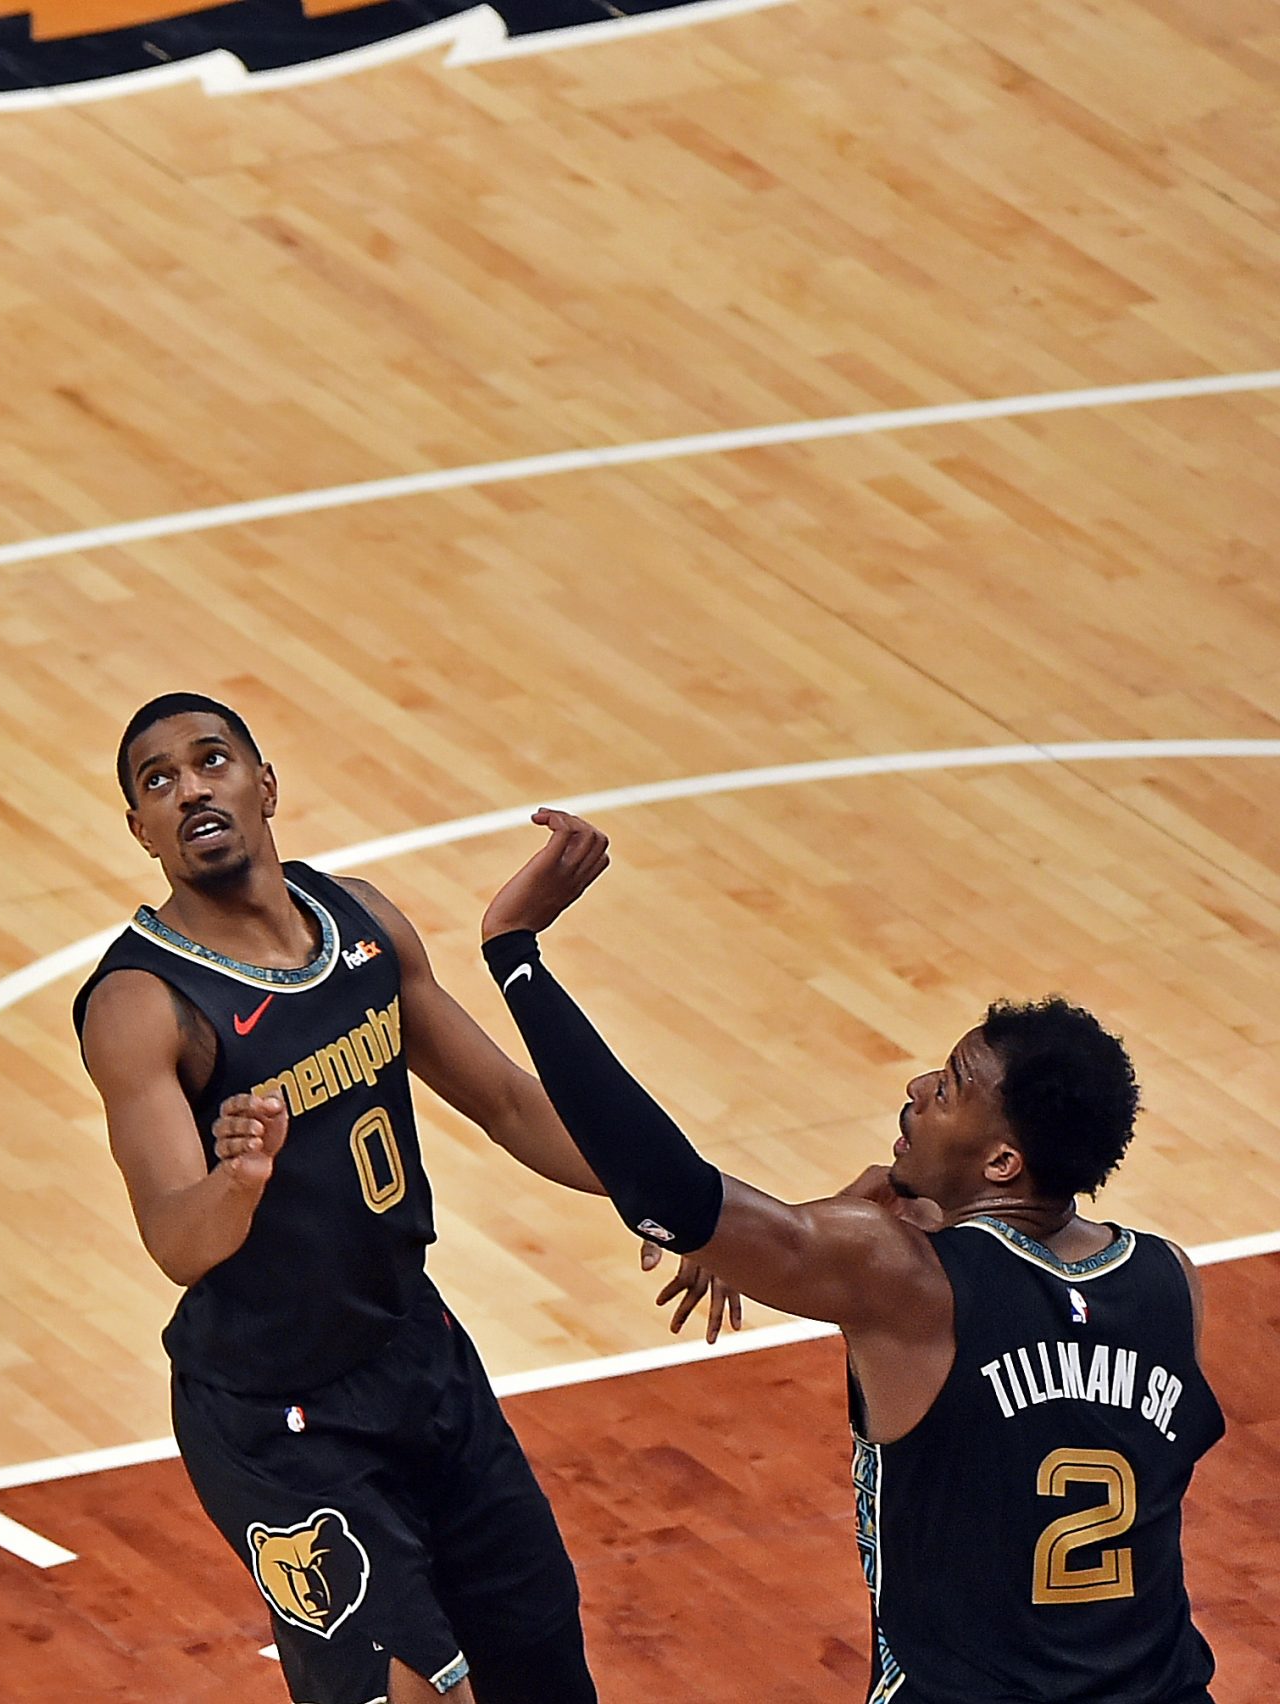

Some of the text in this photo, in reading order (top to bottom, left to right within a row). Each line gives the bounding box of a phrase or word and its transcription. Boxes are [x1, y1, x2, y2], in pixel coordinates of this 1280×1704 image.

[341, 940, 382, 970] FedEx
[349, 1106, 406, 1215] 0
[980, 1341, 1183, 1442] TILLMAN SR.
[1032, 1448, 1136, 1605] 2
